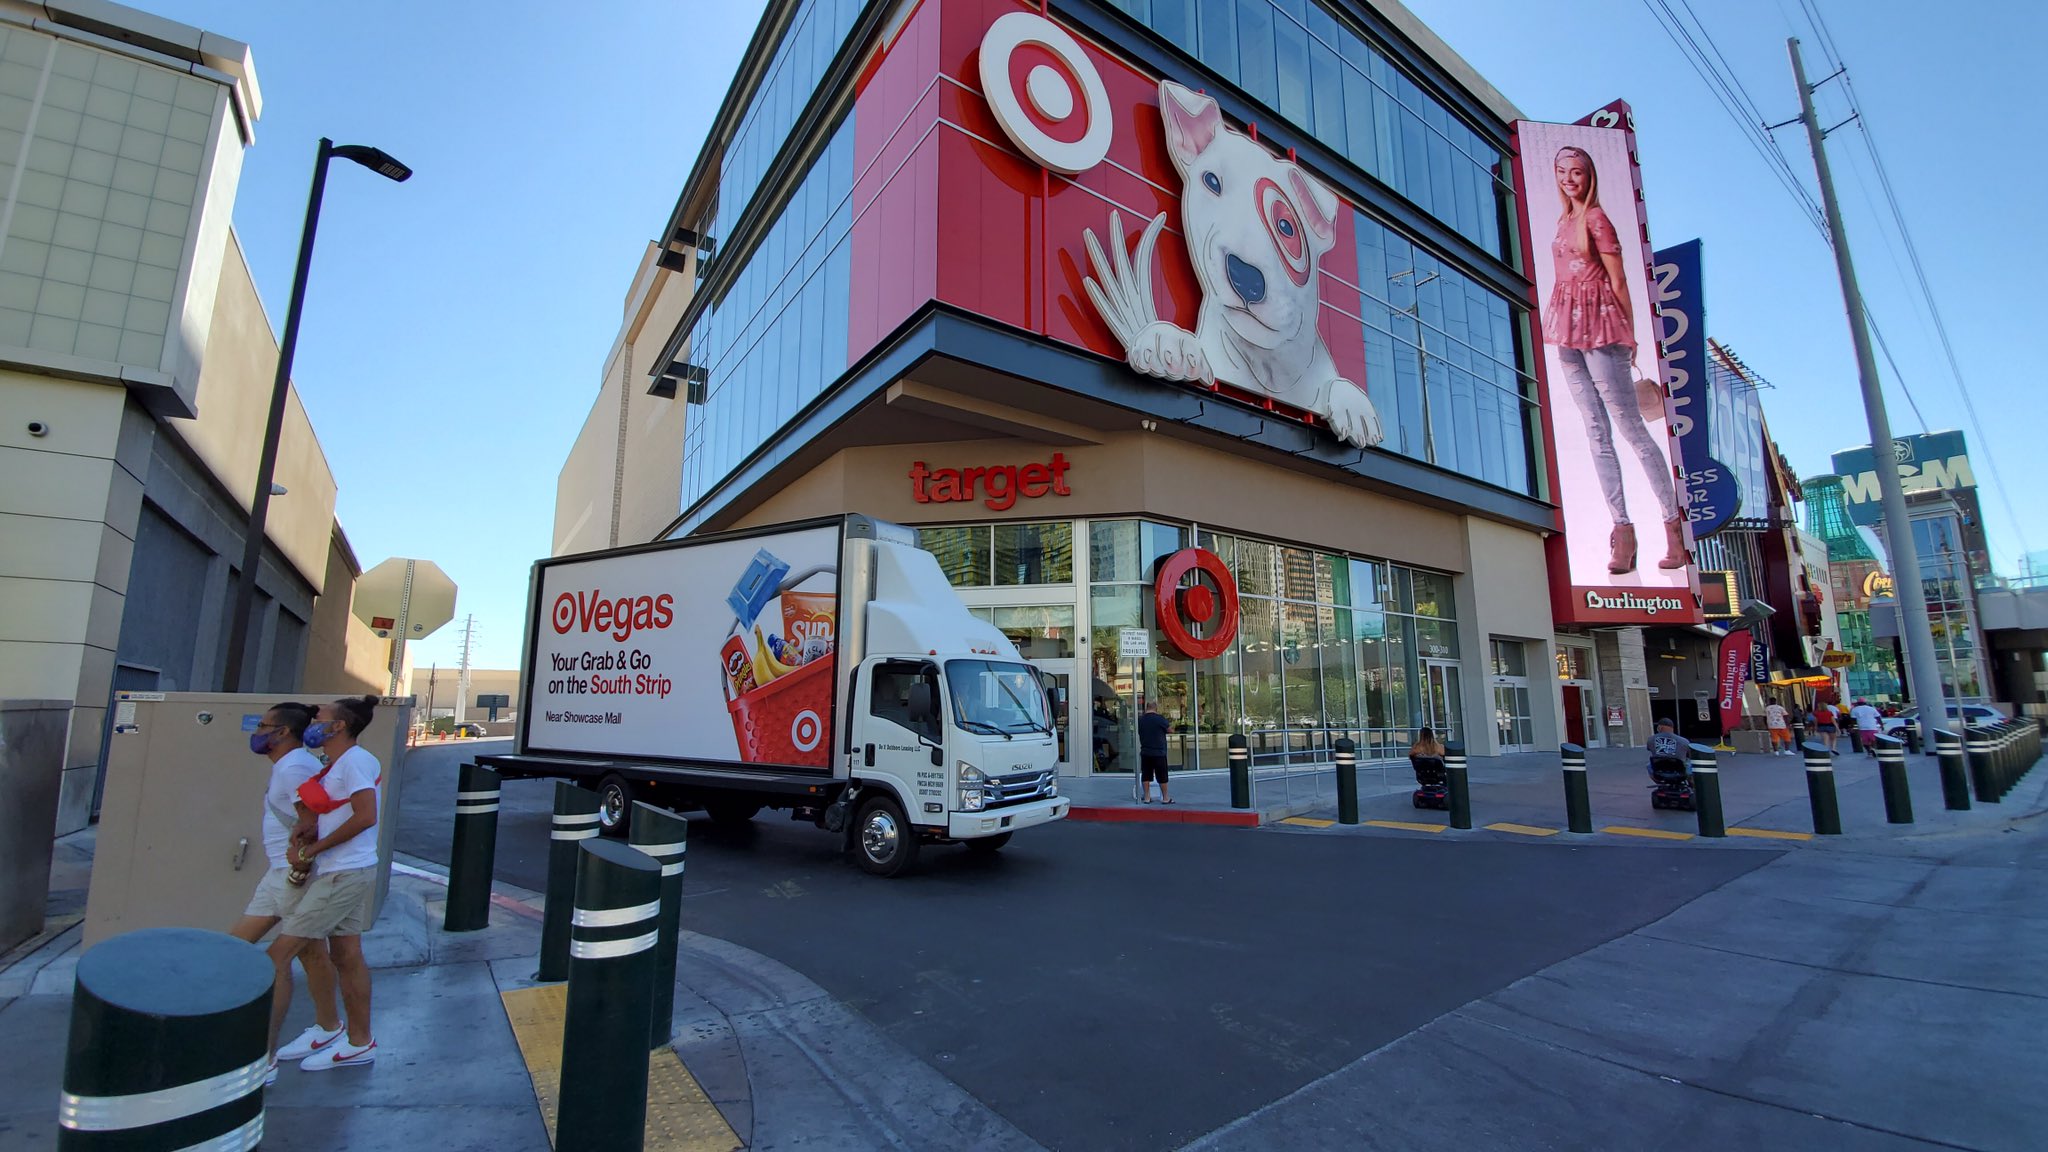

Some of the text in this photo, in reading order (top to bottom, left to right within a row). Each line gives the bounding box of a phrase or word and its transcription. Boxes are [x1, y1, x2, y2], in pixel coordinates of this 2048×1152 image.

[908, 452, 1071, 512] target
[578, 589, 674, 643] Vegas
[1586, 590, 1683, 615] Burlington
[791, 620, 835, 653] Sun
[551, 649, 652, 671] Your Grab & Go
[1738, 662, 1747, 682] OPEN
[1752, 644, 1766, 680] ROSS
[548, 672, 672, 699] on the South Strip
[1720, 649, 1738, 710] Burlington
[545, 710, 622, 724] Near Showcase Mall
[1011, 763, 1033, 772] ISUZU
